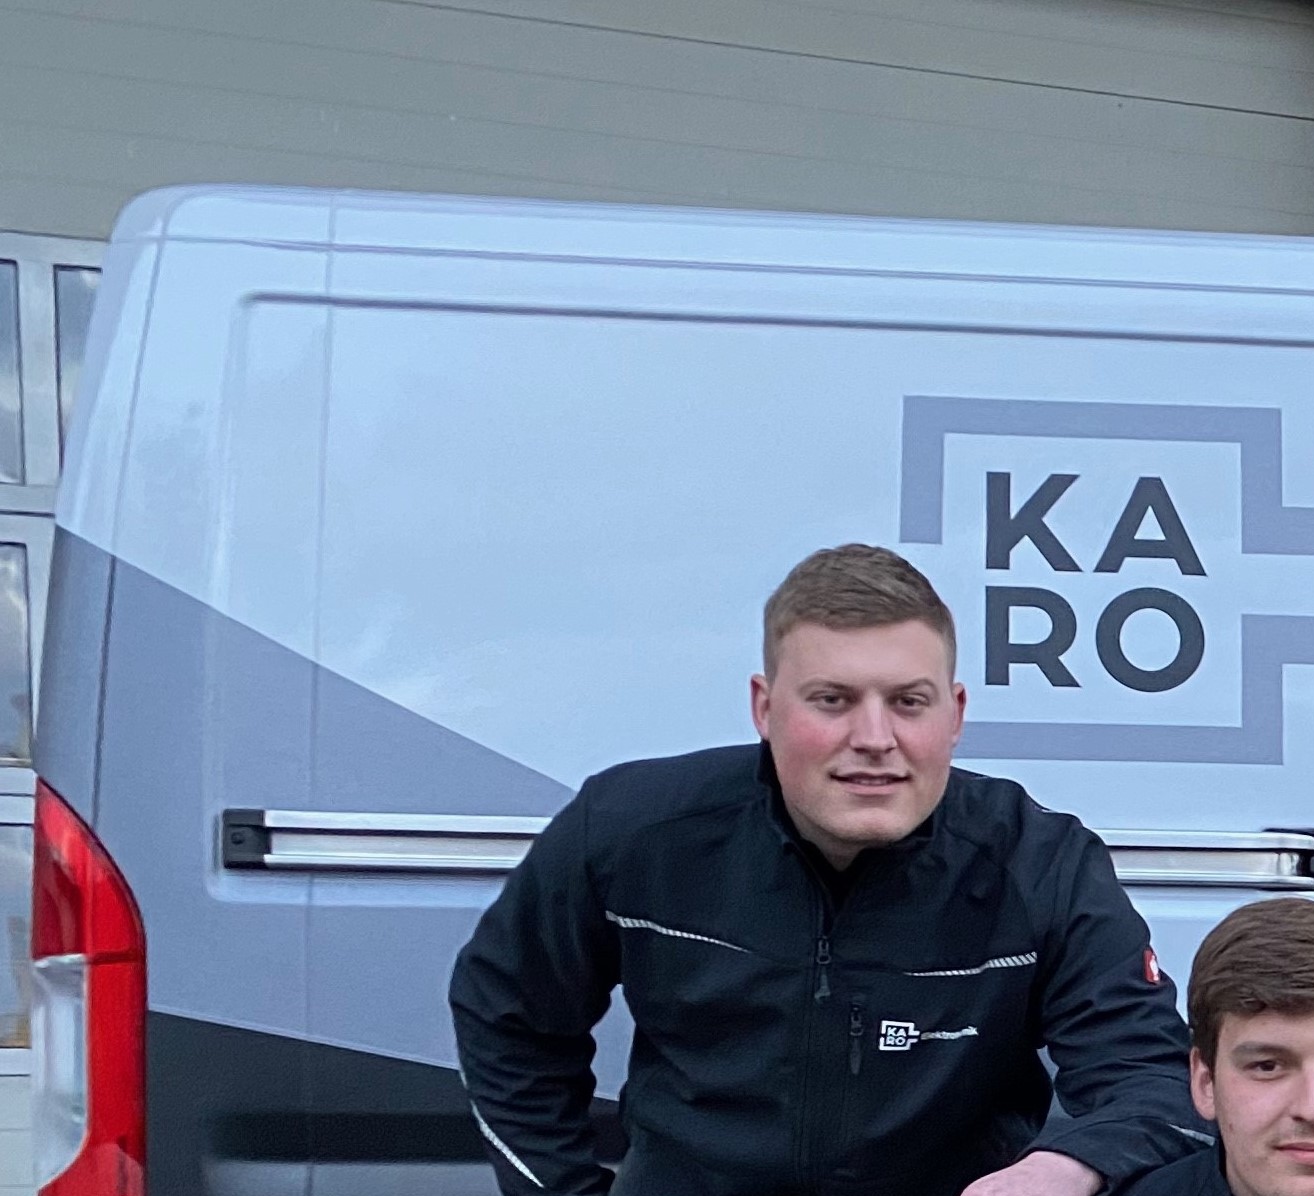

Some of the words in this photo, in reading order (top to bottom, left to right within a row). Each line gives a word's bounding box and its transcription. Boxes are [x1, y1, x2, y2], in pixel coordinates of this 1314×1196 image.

[986, 471, 1207, 577] KA
[985, 585, 1205, 693] RO
[886, 1027, 907, 1037] KA
[886, 1036, 906, 1046] RO
